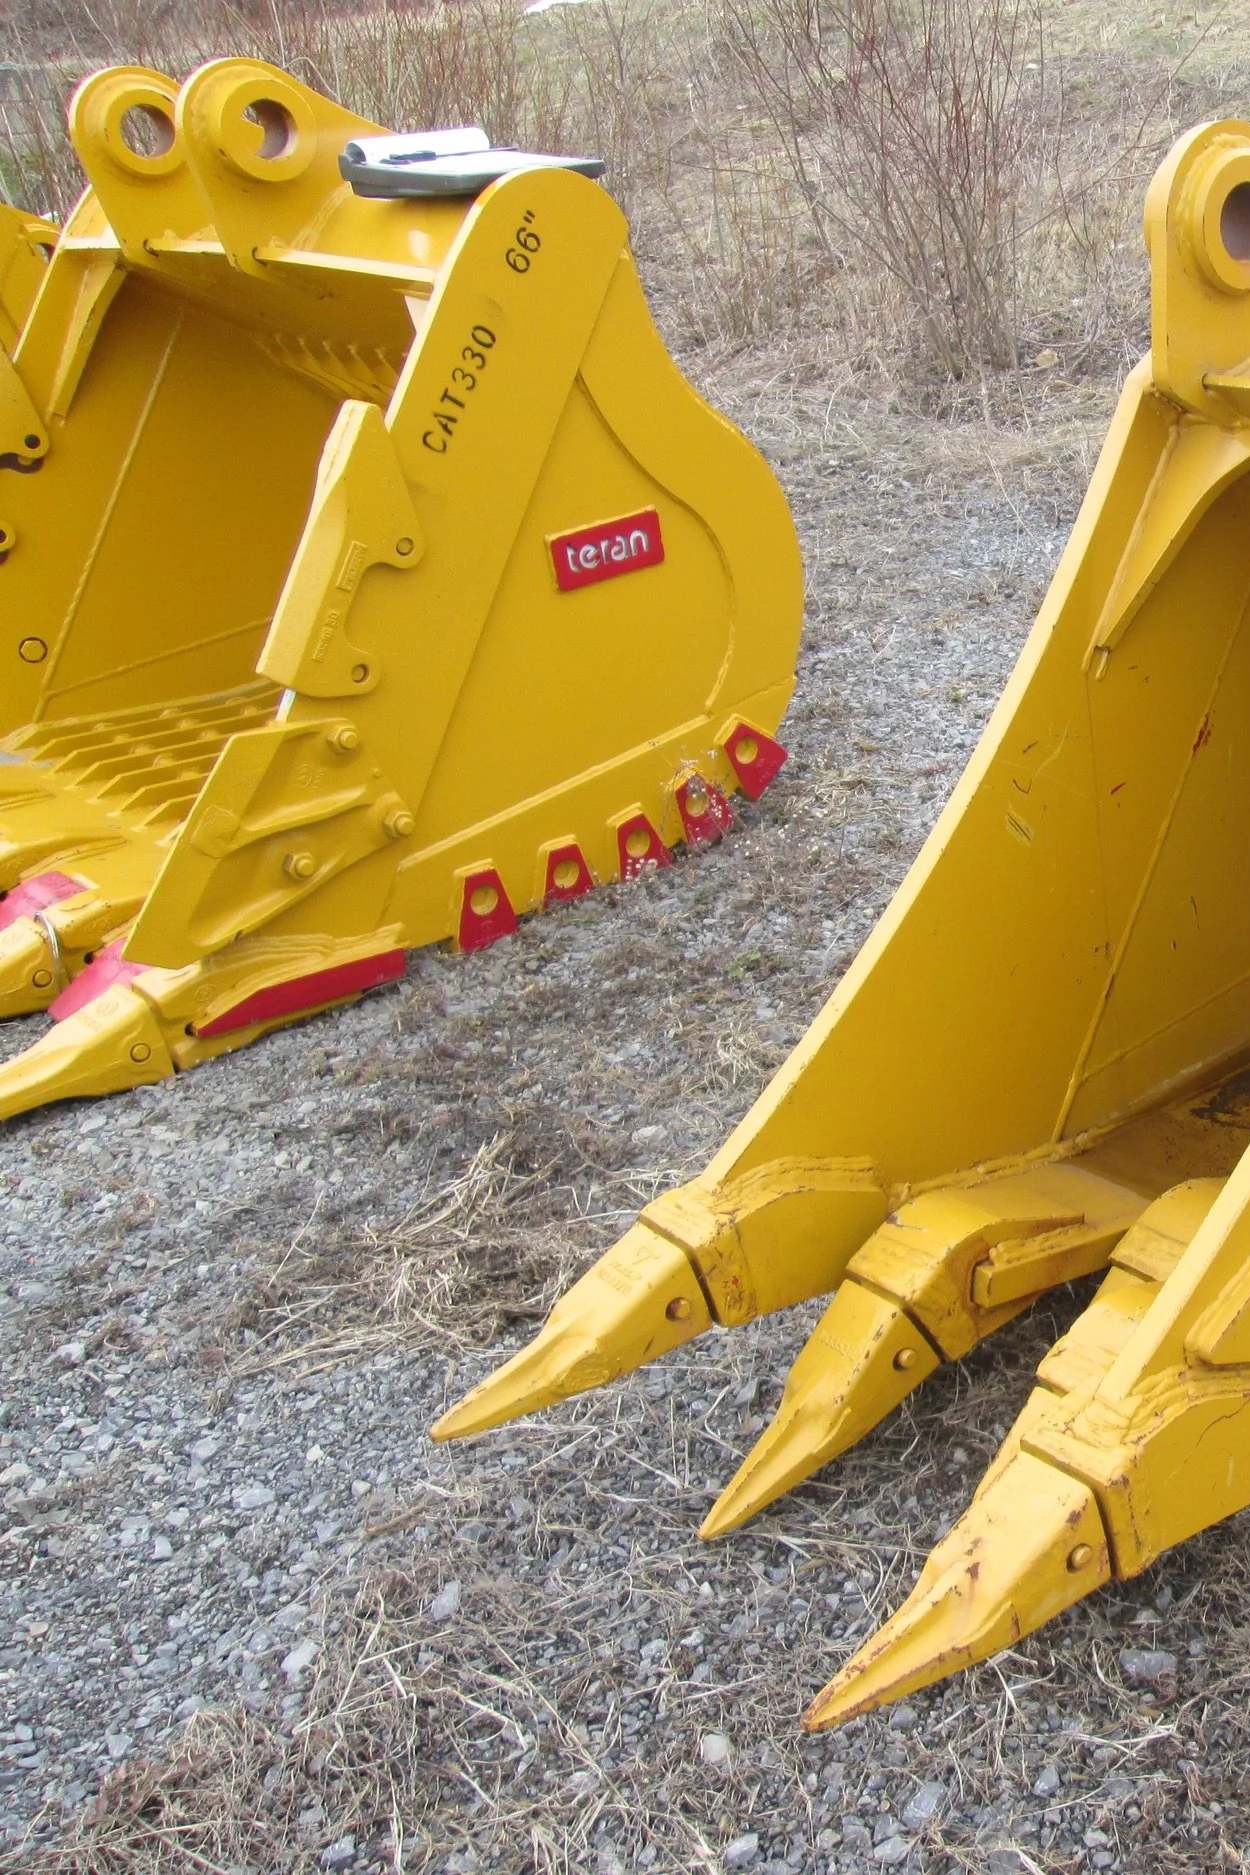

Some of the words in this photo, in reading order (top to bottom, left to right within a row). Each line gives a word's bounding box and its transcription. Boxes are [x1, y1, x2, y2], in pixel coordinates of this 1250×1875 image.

[505, 209, 541, 274] 66"
[422, 325, 496, 453] CAT330
[566, 529, 649, 573] teran
